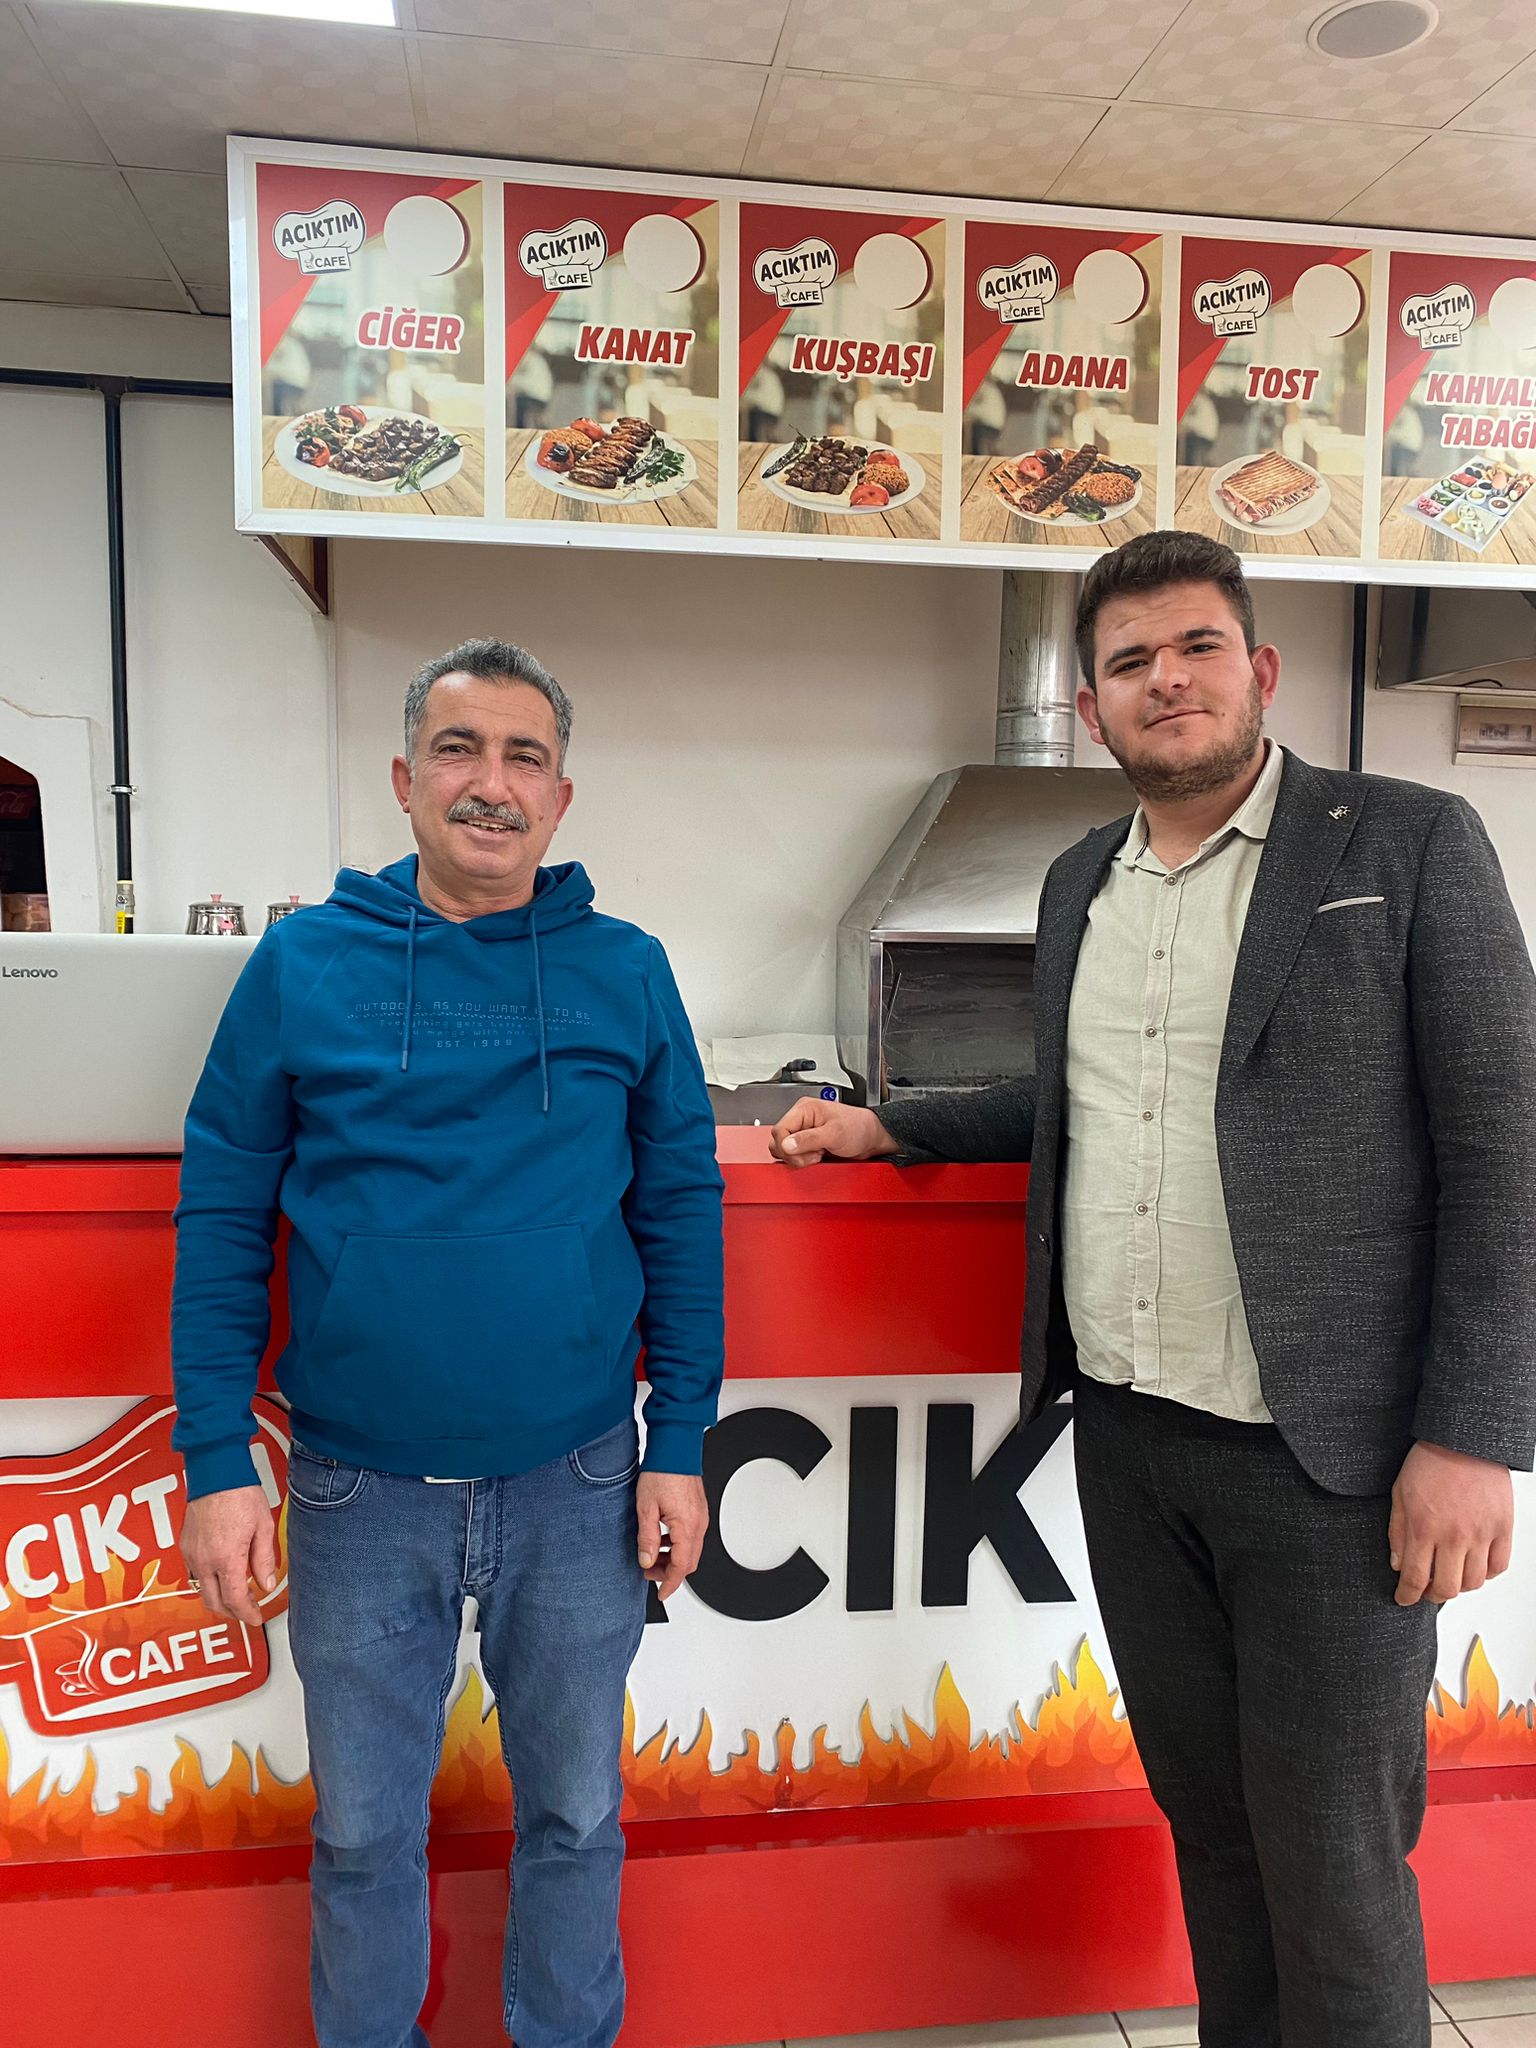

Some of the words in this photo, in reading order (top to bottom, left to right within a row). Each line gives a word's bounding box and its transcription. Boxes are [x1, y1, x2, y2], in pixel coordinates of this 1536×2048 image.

[281, 212, 359, 248] ACIKTIM
[315, 256, 347, 268] CAFE
[526, 231, 601, 265] ACIKTIM
[557, 273, 588, 286] CAFE
[760, 250, 832, 282] ACIKTIM
[984, 266, 1053, 299] ACIKTIM
[790, 290, 819, 303] CAFE
[1013, 306, 1041, 318] CAFE
[1199, 280, 1266, 313] ACIKTIM
[1406, 294, 1470, 326] ACIKTIM
[358, 307, 462, 352] CİĞER
[1226, 319, 1254, 332] CAFE
[1432, 333, 1458, 345] CAFE
[577, 325, 693, 365] KANAT
[792, 337, 935, 382] KUŞBAŞI
[1019, 353, 1128, 390] ADANA
[1247, 366, 1319, 401] TOST
[1427, 373, 1536, 408] KAHVAL
[2, 965, 59, 979] Lenovo
[355, 1001, 426, 1012] OUTDOOS.
[433, 1001, 449, 1010] AS
[458, 1002, 481, 1012] YOU
[488, 1003, 527, 1014] WANT
[554, 1007, 569, 1017] TO
[0, 1442, 282, 1613] CIKT
[636, 1403, 1077, 1634] CIK
[100, 1622, 235, 1686] CAFE
